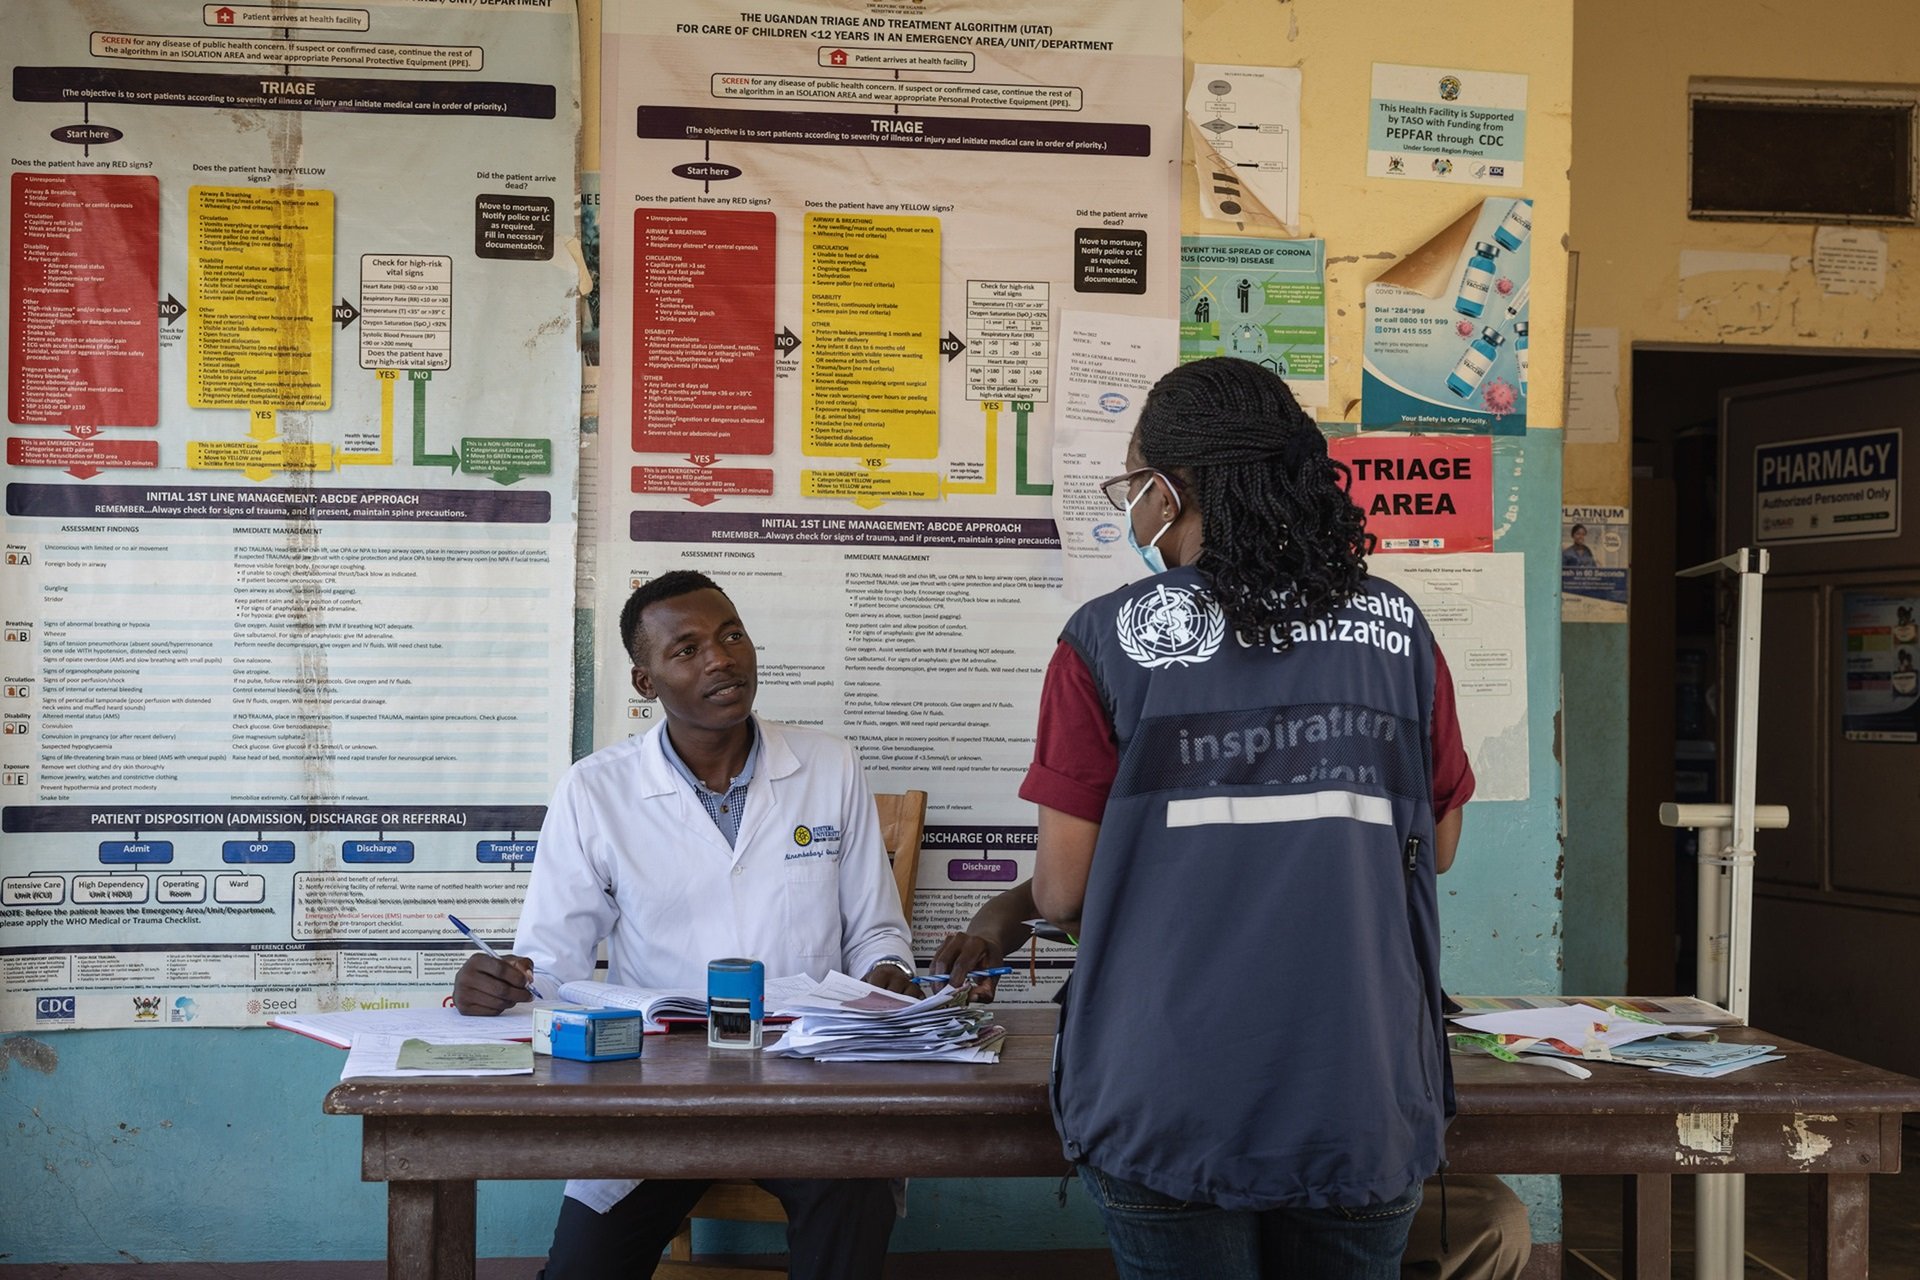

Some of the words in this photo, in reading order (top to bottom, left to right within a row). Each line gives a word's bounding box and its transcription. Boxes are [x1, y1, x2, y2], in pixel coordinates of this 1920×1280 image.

[272, 14, 298, 22] arrives
[309, 15, 334, 23] health
[336, 16, 361, 25] facility
[740, 13, 761, 22] THE
[764, 14, 817, 24] UGANDAN
[820, 16, 859, 26] TRIAGE
[862, 18, 885, 27] AND
[888, 19, 952, 30] TREATMENT
[954, 22, 1017, 33] ALGORITHM
[1020, 25, 1052, 36] (UTAT)
[676, 24, 698, 33] FOR
[702, 25, 731, 34] CARE
[734, 26, 749, 35] OF
[752, 27, 807, 38] CHILDREN
[810, 30, 831, 39] <12
[834, 30, 869, 41] YEARS
[874, 32, 884, 41] IN
[887, 33, 902, 42] AN
[906, 34, 973, 45] EMERGENCY
[975, 37, 1113, 50] AREA/UNIT/DEPARTMENT
[260, 81, 315, 95] TRIAGE
[1380, 103, 1396, 112] This
[1398, 105, 1427, 114] Health
[1429, 107, 1459, 119] Facility
[1461, 110, 1468, 118] is
[1469, 110, 1514, 121] Supported
[871, 120, 923, 133] TRIAGE
[1388, 114, 1399, 124] by
[1401, 116, 1424, 125] TASO
[1425, 118, 1445, 126] with
[1447, 119, 1481, 131] Funding
[1483, 122, 1503, 131] from
[66, 130, 87, 138] Start
[89, 129, 109, 138] here
[1386, 127, 1432, 141] PEPFAR
[1437, 133, 1474, 146] through
[1479, 134, 1504, 146] CDC
[1462, 148, 1483, 156] Project
[687, 166, 708, 175] Start
[710, 166, 730, 176] here
[479, 202, 501, 210] Move
[512, 205, 549, 213] mortuary.
[482, 212, 506, 220] Notify
[507, 213, 530, 221] police
[501, 223, 535, 231] required.
[485, 231, 496, 239] Fill
[507, 234, 543, 242] necessary
[485, 240, 544, 250] documentation.
[1196, 255, 1238, 264] (COVID-19)
[161, 304, 178, 314] NO
[336, 309, 352, 318] NO
[778, 337, 794, 346] NO
[942, 341, 958, 350] NO
[379, 371, 395, 379] YES
[412, 371, 428, 381] NO
[255, 411, 271, 419] YES
[1418, 415, 1439, 423] Safety
[1461, 417, 1487, 425] Priority.
[75, 425, 91, 434] YES
[1352, 458, 1471, 480] TRIAGE
[1763, 443, 1890, 485] PHARMACY
[147, 492, 184, 501] INITIAL
[187, 492, 207, 501] 1ST
[210, 492, 234, 502] LINE
[237, 493, 317, 503] MANAGEMENT:
[320, 494, 357, 503] ABCDE
[360, 495, 419, 504] APPROACH
[1762, 494, 1812, 508] Authorized
[1815, 489, 1864, 504] Personnel
[1866, 488, 1890, 501] Only
[1369, 493, 1456, 515] AREA
[1562, 508, 1623, 518] LATINUM
[1331, 590, 1414, 628] ealth
[1236, 612, 1411, 657] ganizatio
[1179, 706, 1397, 764] inspiration
[91, 814, 142, 824] PATIENT
[145, 813, 223, 824] DISPOSITION
[227, 813, 306, 826] (ADMISSION,
[310, 813, 378, 824] DISCHARGE
[381, 814, 399, 824] OR
[403, 813, 466, 826] REFERRAL)
[986, 833, 1002, 843] OR
[123, 844, 150, 852] Admit
[249, 844, 268, 852] OPD
[356, 844, 396, 854] Discharge
[490, 843, 524, 854] Transfer
[525, 845, 537, 854] or
[502, 852, 523, 860] Refer
[962, 862, 1000, 872] Discharge
[78, 881, 96, 890] High
[97, 881, 144, 891] Dependency
[162, 880, 199, 888] Operating
[38, 999, 74, 1013] CDC
[263, 999, 297, 1010] Seed
[360, 997, 410, 1010] walimu
